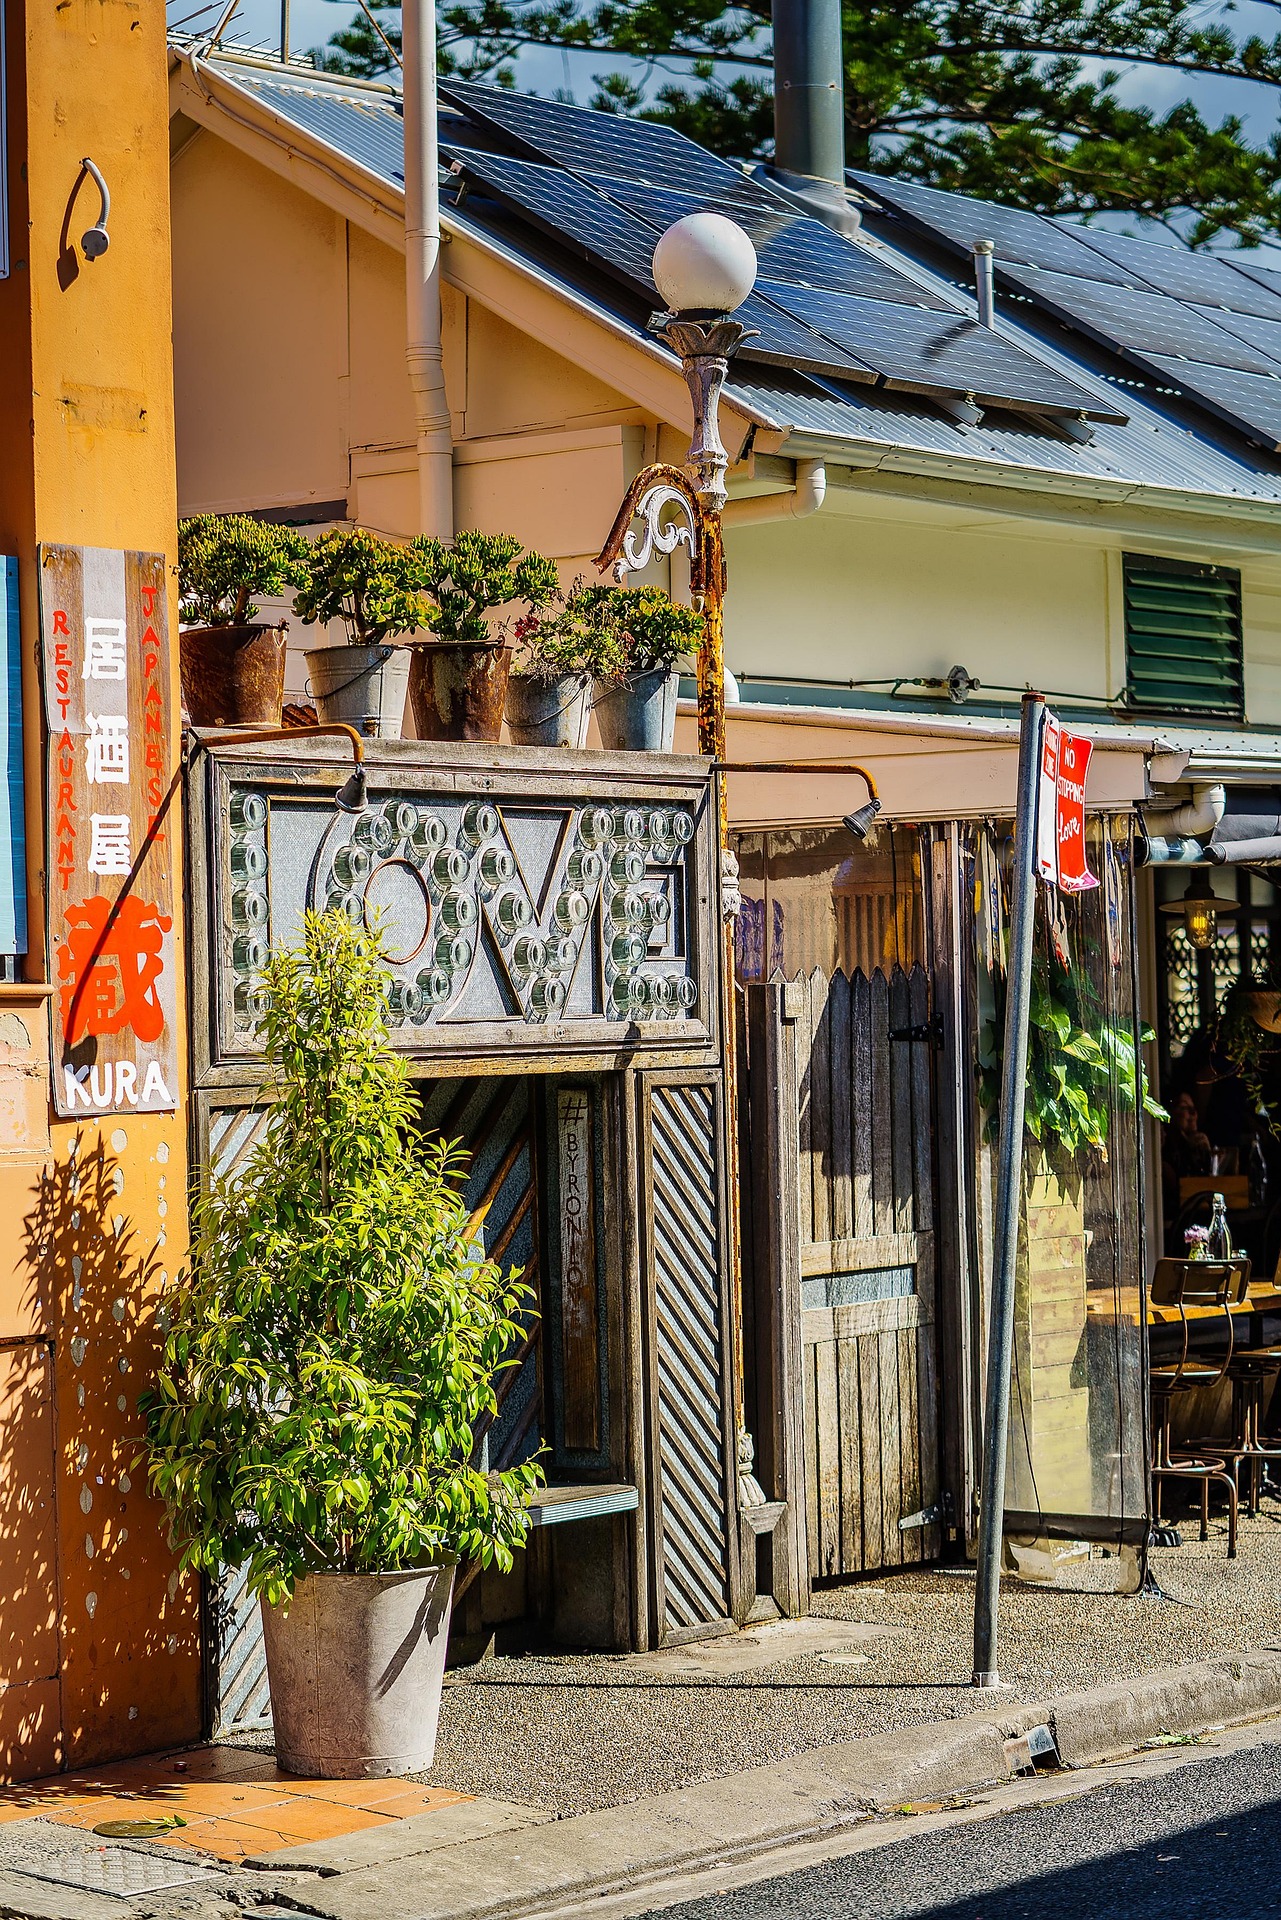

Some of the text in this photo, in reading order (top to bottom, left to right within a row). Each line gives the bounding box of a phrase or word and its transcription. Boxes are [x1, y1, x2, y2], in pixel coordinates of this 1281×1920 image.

[52, 610, 78, 891] RESTAURANT
[81, 616, 132, 876] 居酒屋
[141, 586, 166, 842] JAPANESE
[1064, 746, 1076, 769] NO
[1057, 776, 1084, 805] STOPPING
[1058, 812, 1081, 844] Love
[230, 790, 698, 1030] LOVE
[63, 1060, 171, 1110] KURA
